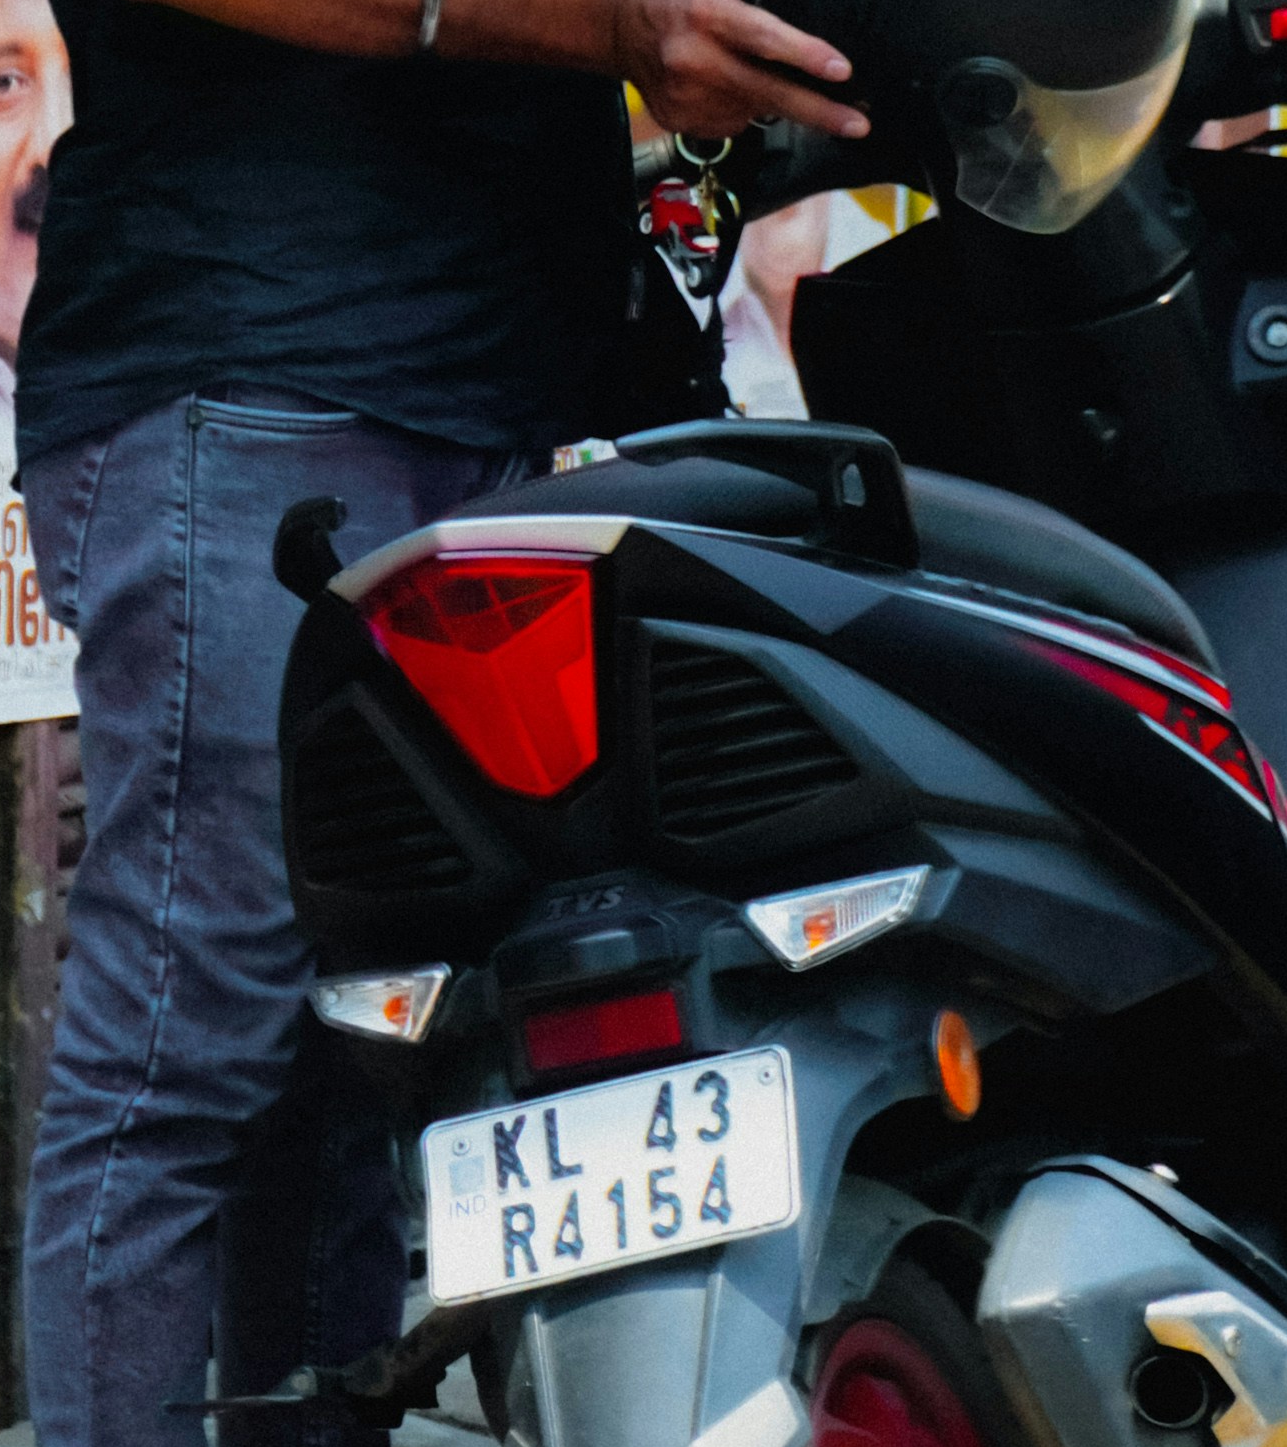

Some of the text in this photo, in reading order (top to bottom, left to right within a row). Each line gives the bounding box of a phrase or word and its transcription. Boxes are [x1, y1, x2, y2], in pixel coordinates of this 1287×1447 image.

[492, 1069, 731, 1190] KL 43
[448, 1194, 487, 1218] IND
[501, 1153, 732, 1278] R4154
